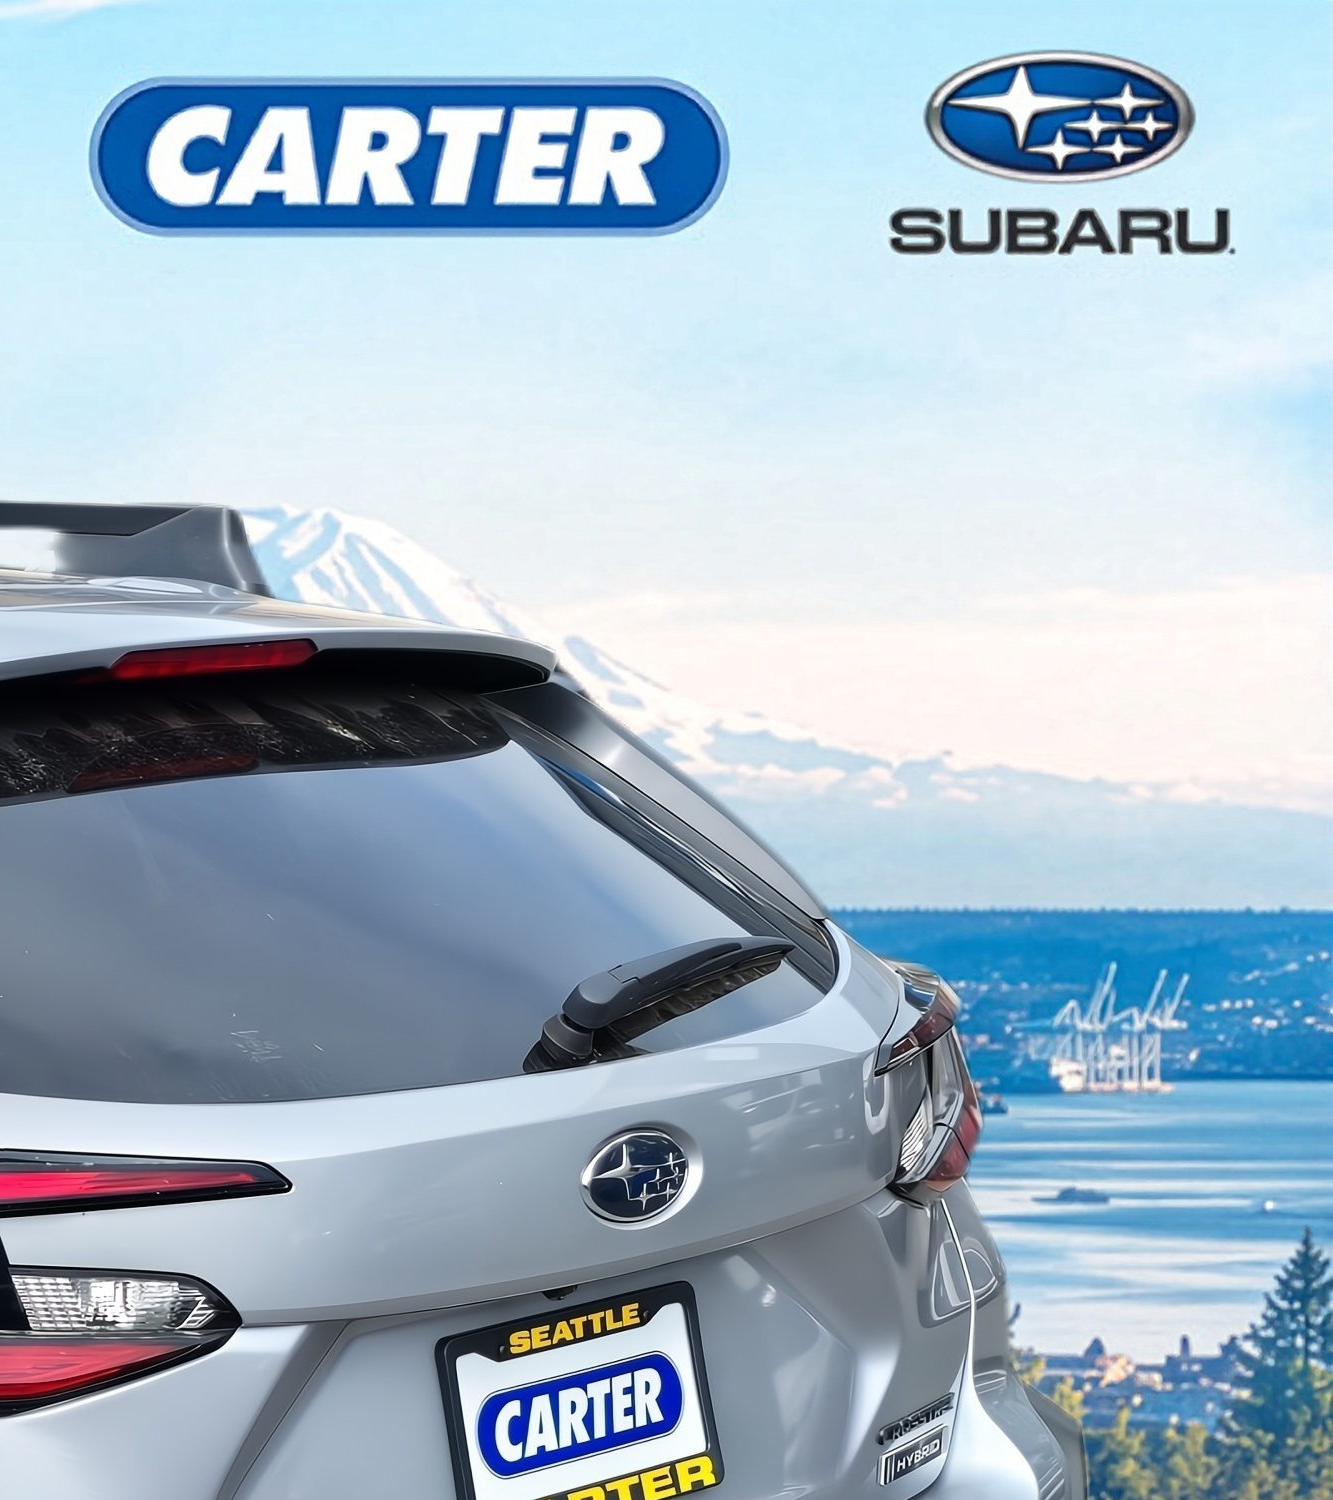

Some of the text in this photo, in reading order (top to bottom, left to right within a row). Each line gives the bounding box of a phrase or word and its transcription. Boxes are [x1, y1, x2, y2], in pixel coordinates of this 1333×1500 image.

[509, 1303, 640, 1354] SEATTLE
[494, 1367, 664, 1463] CARTER
[896, 1439, 941, 1472] HYBRID
